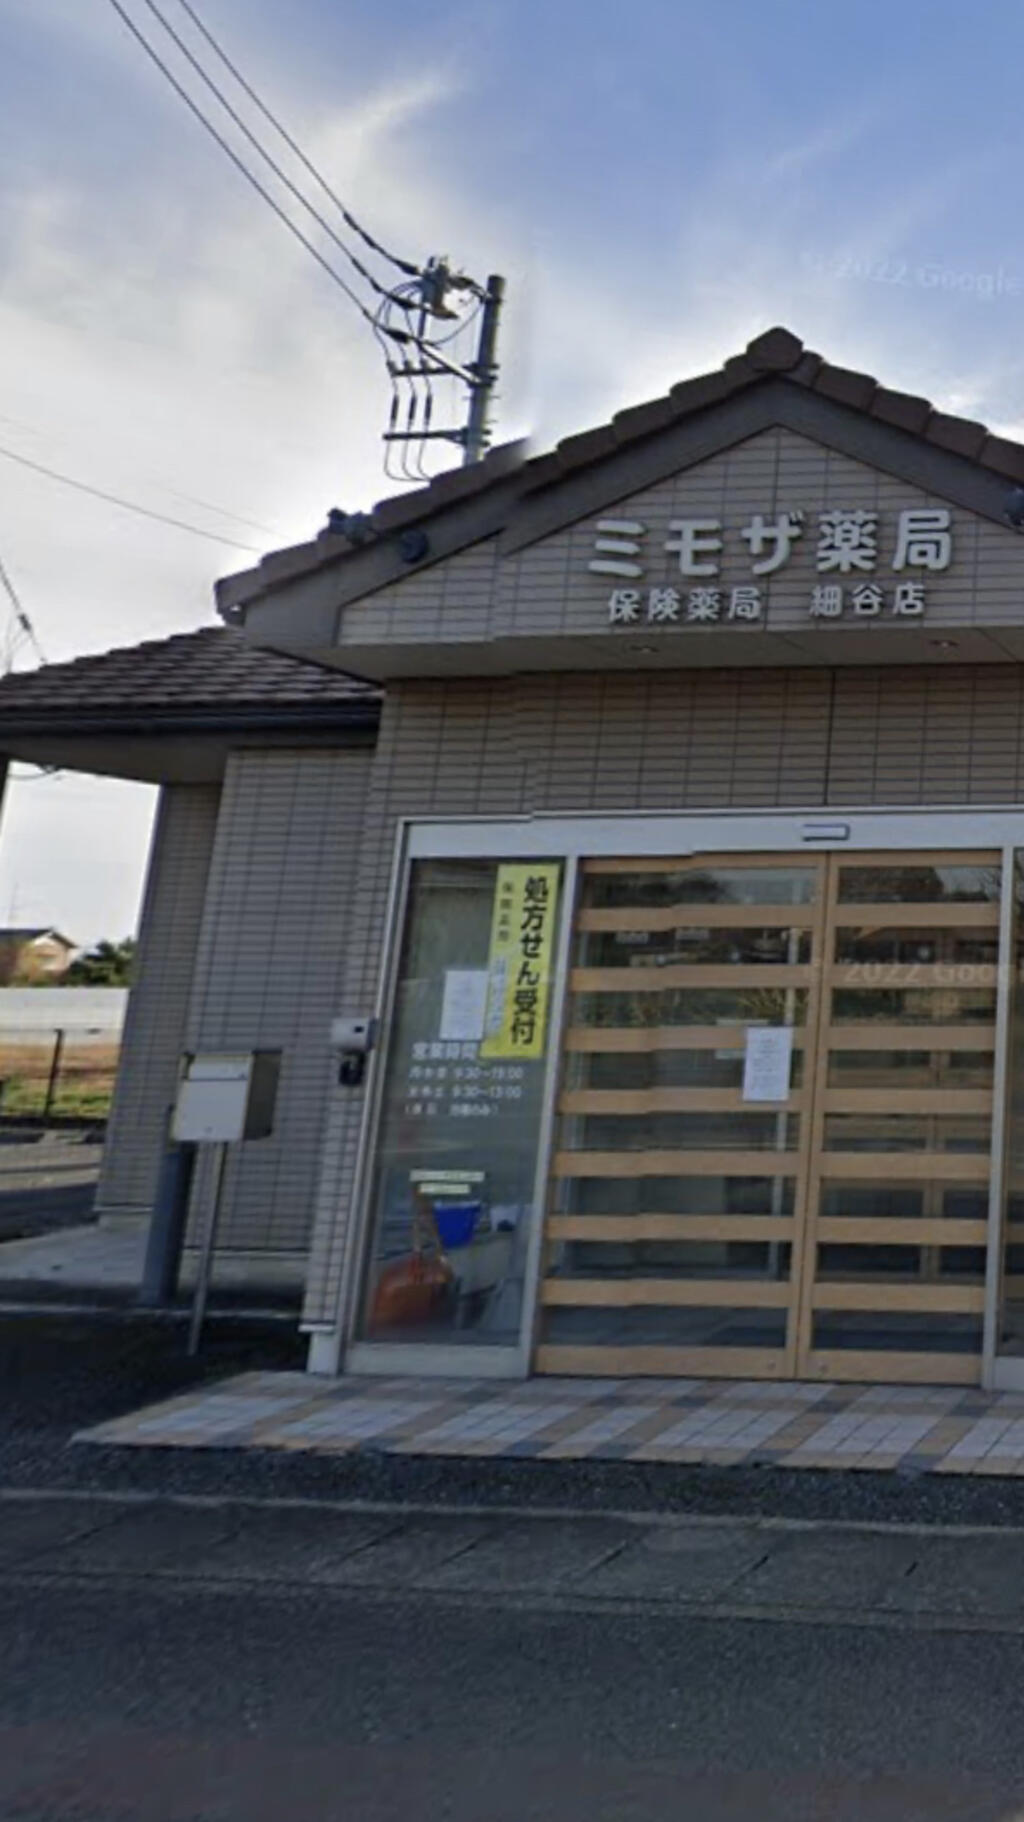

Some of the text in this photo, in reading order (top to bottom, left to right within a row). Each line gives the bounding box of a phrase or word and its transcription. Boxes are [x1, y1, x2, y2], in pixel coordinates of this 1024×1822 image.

[588, 508, 953, 579] ミモザ薬局
[607, 582, 926, 624] 保険薬局 細谷店
[510, 875, 549, 1045] 処方せん受付
